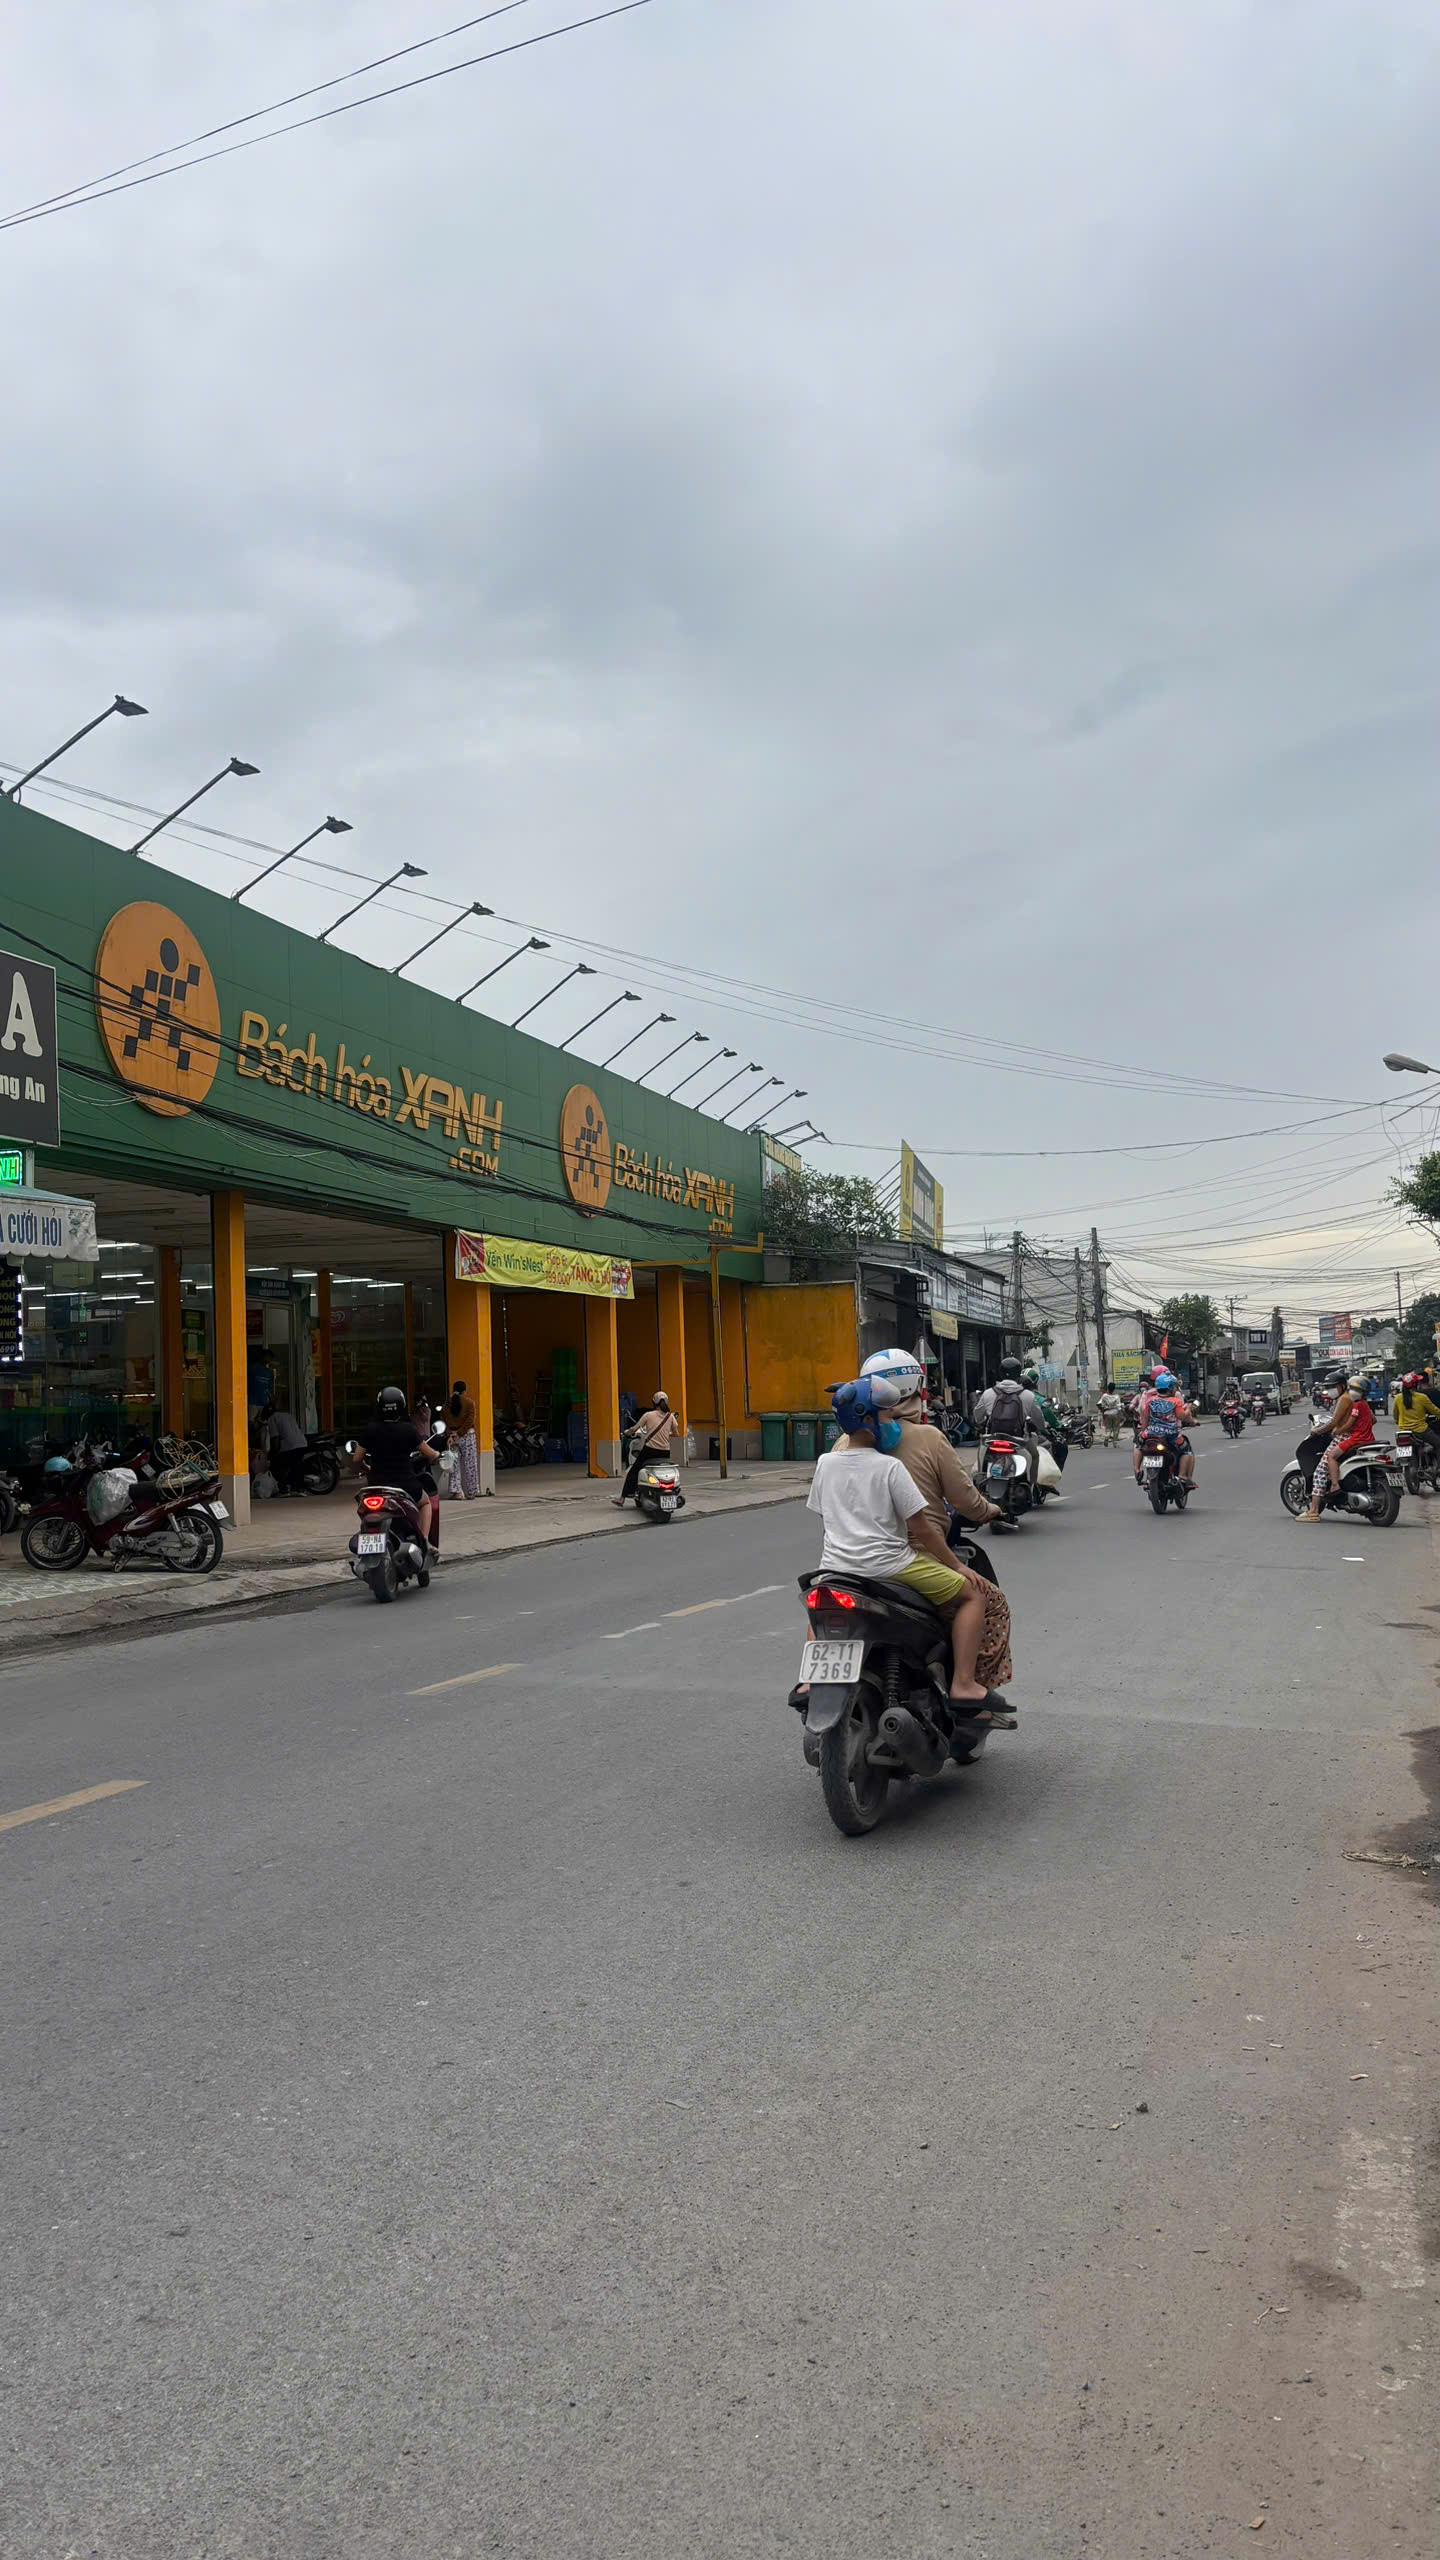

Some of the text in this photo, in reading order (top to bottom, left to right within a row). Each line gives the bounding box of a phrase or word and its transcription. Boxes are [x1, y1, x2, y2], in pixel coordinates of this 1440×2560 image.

[1, 970, 43, 1058] A
[25, 1076, 46, 1104] An
[236, 1010, 503, 1151] Bách hóa XANH
[613, 1141, 735, 1219] Bách hóa XANH
[8, 1208, 38, 1245] CƯỚI
[42, 1207, 62, 1247] HỎI
[809, 1662, 852, 1680] 7369
[812, 1644, 854, 1661] 62-T1
